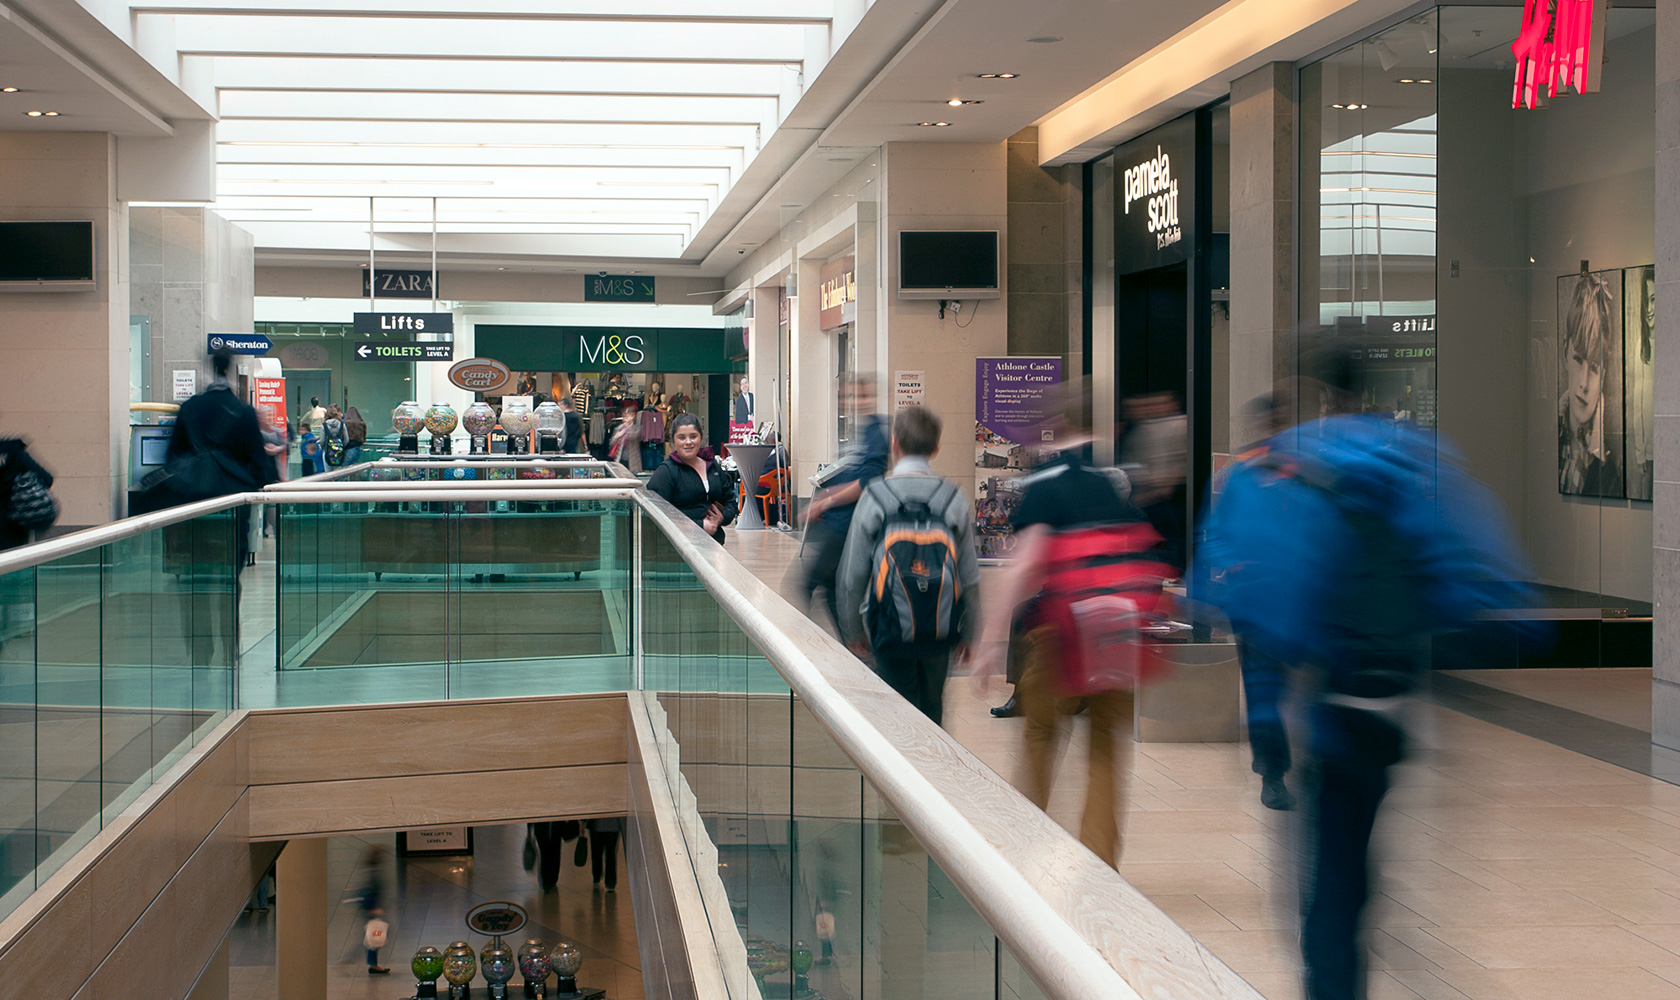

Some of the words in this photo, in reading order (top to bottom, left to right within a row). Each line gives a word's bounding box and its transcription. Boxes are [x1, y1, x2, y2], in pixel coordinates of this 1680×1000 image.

[1124, 144, 1170, 215] pamela
[1147, 178, 1179, 233] scott
[381, 273, 434, 291] ZARA
[600, 279, 635, 296] M&S
[820, 282, 828, 311] The
[381, 315, 425, 330] Lifts
[225, 339, 269, 350] Sheraton
[375, 346, 422, 357] TOILETS
[579, 334, 645, 365] M&S
[995, 362, 1028, 371] Athlone
[1029, 362, 1055, 371] Castle
[461, 370, 499, 380] Candy
[464, 378, 492, 387] Cart
[995, 373, 1023, 382] Visitor
[1024, 373, 1053, 382] Centre
